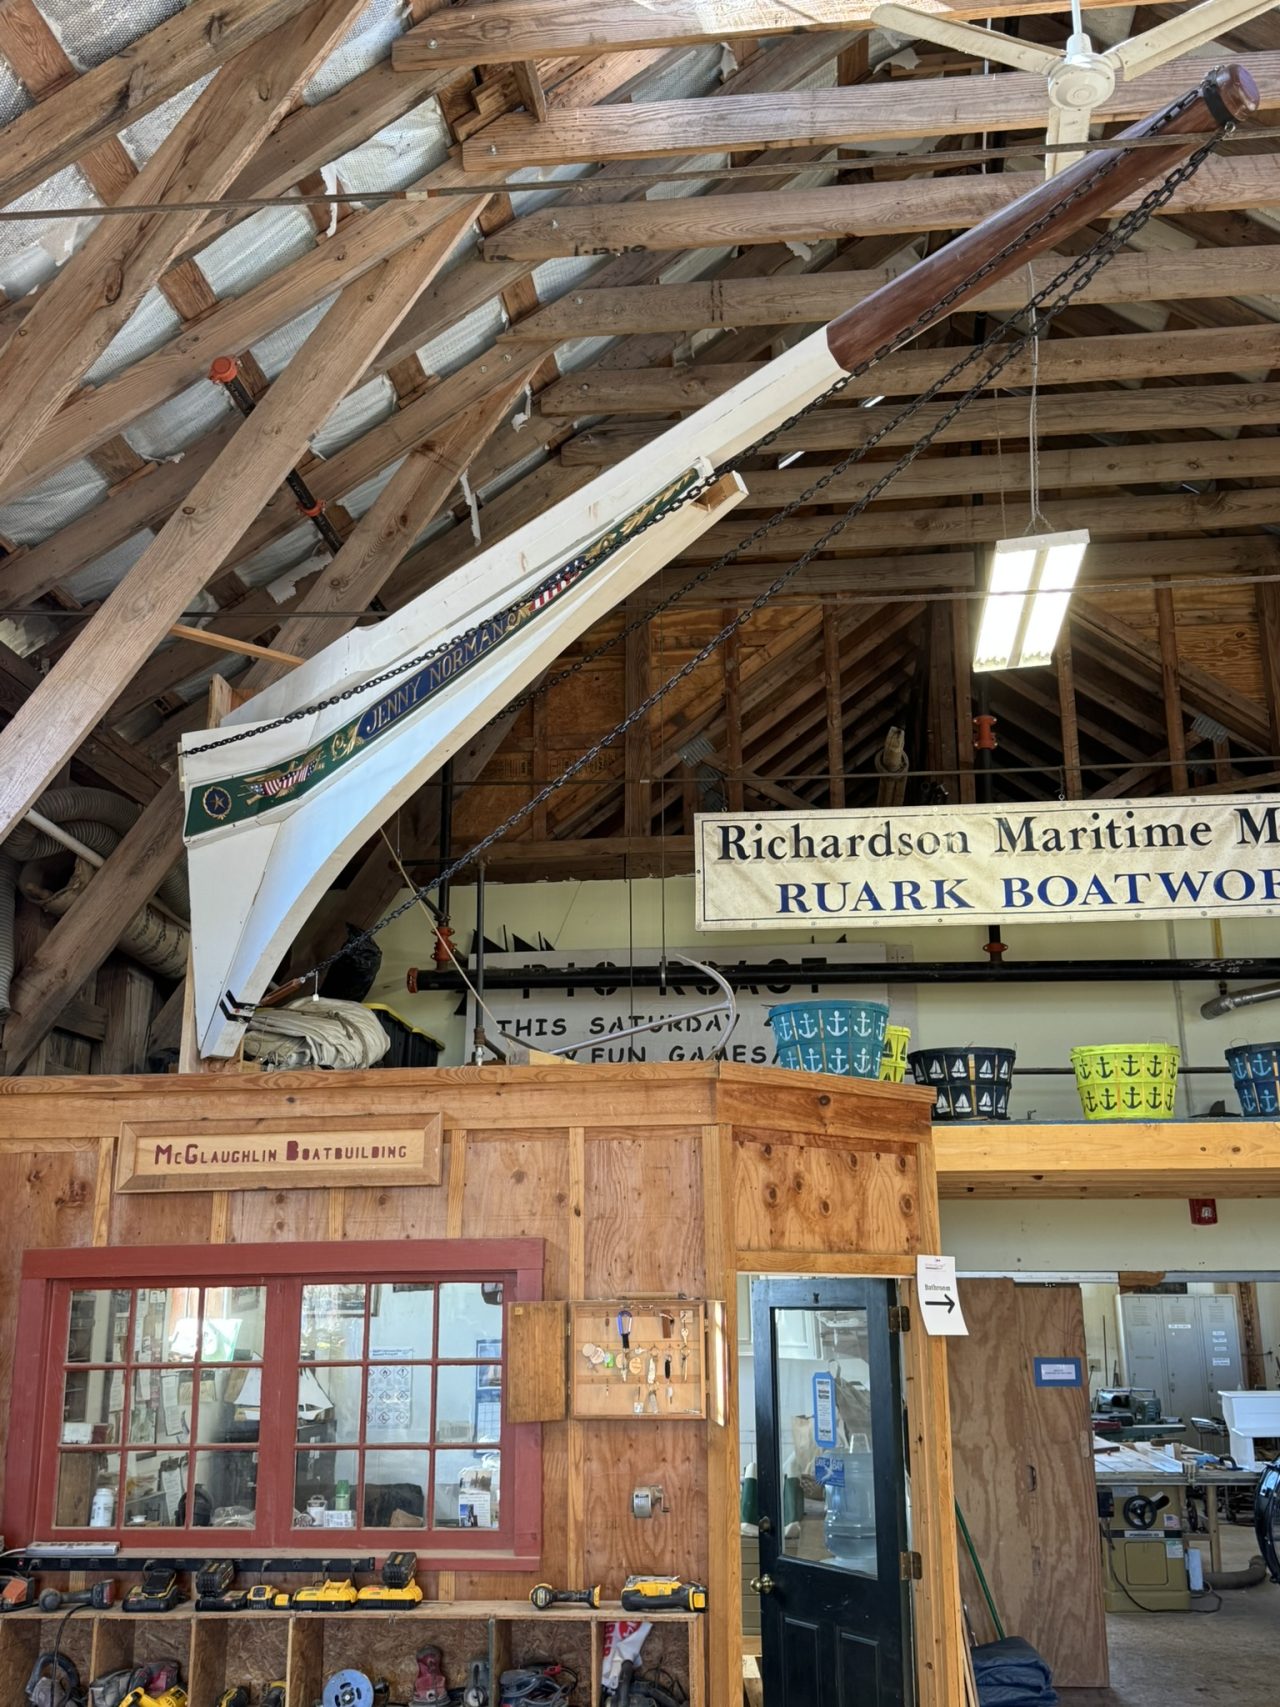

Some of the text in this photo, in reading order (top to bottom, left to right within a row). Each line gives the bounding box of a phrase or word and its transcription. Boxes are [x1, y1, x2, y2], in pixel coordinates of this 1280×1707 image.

[366, 622, 504, 733] JENNY NORMAN
[716, 820, 970, 862] Richardson
[993, 810, 1213, 853] Maritime
[775, 878, 975, 914] RUARK
[496, 1018, 567, 1037] THIS
[591, 1046, 646, 1064] FUN
